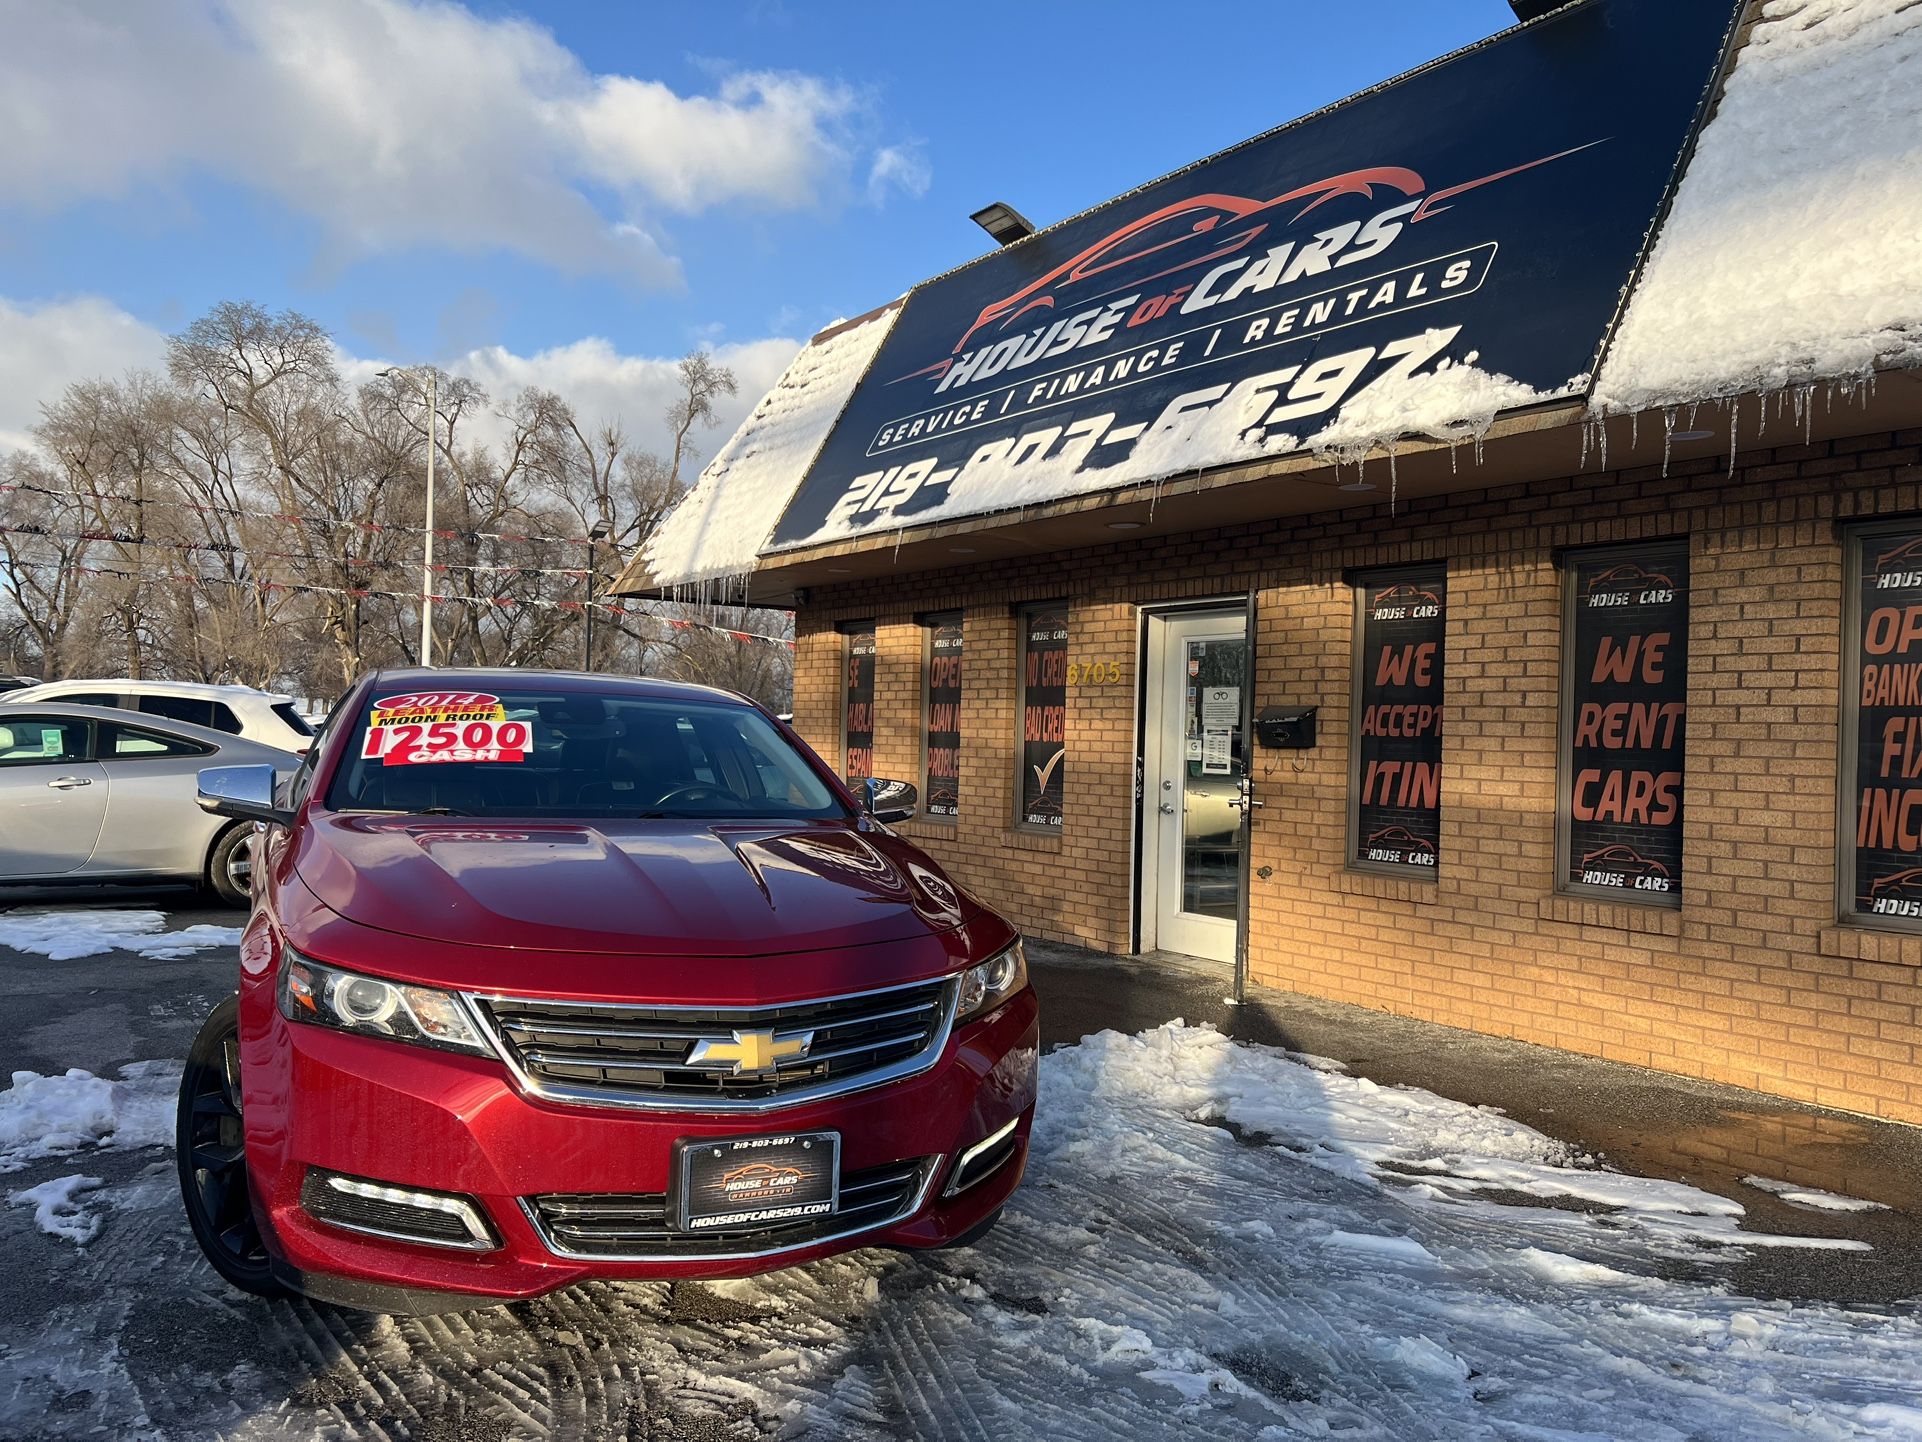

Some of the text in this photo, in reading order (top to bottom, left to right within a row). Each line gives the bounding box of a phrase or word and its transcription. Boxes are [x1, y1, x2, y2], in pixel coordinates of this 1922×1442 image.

[934, 199, 1424, 394] HOUSE OF CARS
[878, 400, 989, 446] SERVICE
[1027, 342, 1185, 405] FINANCE
[1242, 260, 1472, 344] RENTALS
[1374, 607, 1406, 621] HOUSE
[1413, 605, 1439, 618] CARS
[1588, 591, 1630, 608] HOUSE
[1639, 589, 1674, 604] CARS
[1026, 651, 1039, 687] NO
[1374, 642, 1436, 687] WE
[1590, 632, 1671, 684] WE
[849, 658, 860, 688] SE
[1067, 661, 1121, 685] 6705
[1861, 663, 1922, 706] BANK
[376, 704, 498, 719] LEATHER
[396, 694, 480, 708] 2014
[378, 712, 497, 726] MOON ROOF
[929, 703, 952, 732] LOAN
[1025, 706, 1066, 742] BAD CRED
[1361, 704, 1443, 737] ACCEPT
[1574, 702, 1686, 750] RENT
[364, 722, 528, 756] 12500
[407, 750, 501, 763] CASH
[1361, 760, 1442, 809] ITIN
[1572, 768, 1682, 826] CARS
[1857, 787, 1922, 852] INC
[1368, 848, 1400, 862] HOUSE
[1408, 852, 1435, 866] CARS
[1582, 870, 1625, 887] HOUSE
[1634, 875, 1670, 892] CARS
[1872, 898, 1922, 917] HOUS
[733, 1137, 796, 1150] 219-803-6697
[725, 1179, 762, 1192] HOUSE
[769, 1175, 798, 1187] CARS
[690, 1203, 831, 1229] HOUSEOFCARS219.COM
